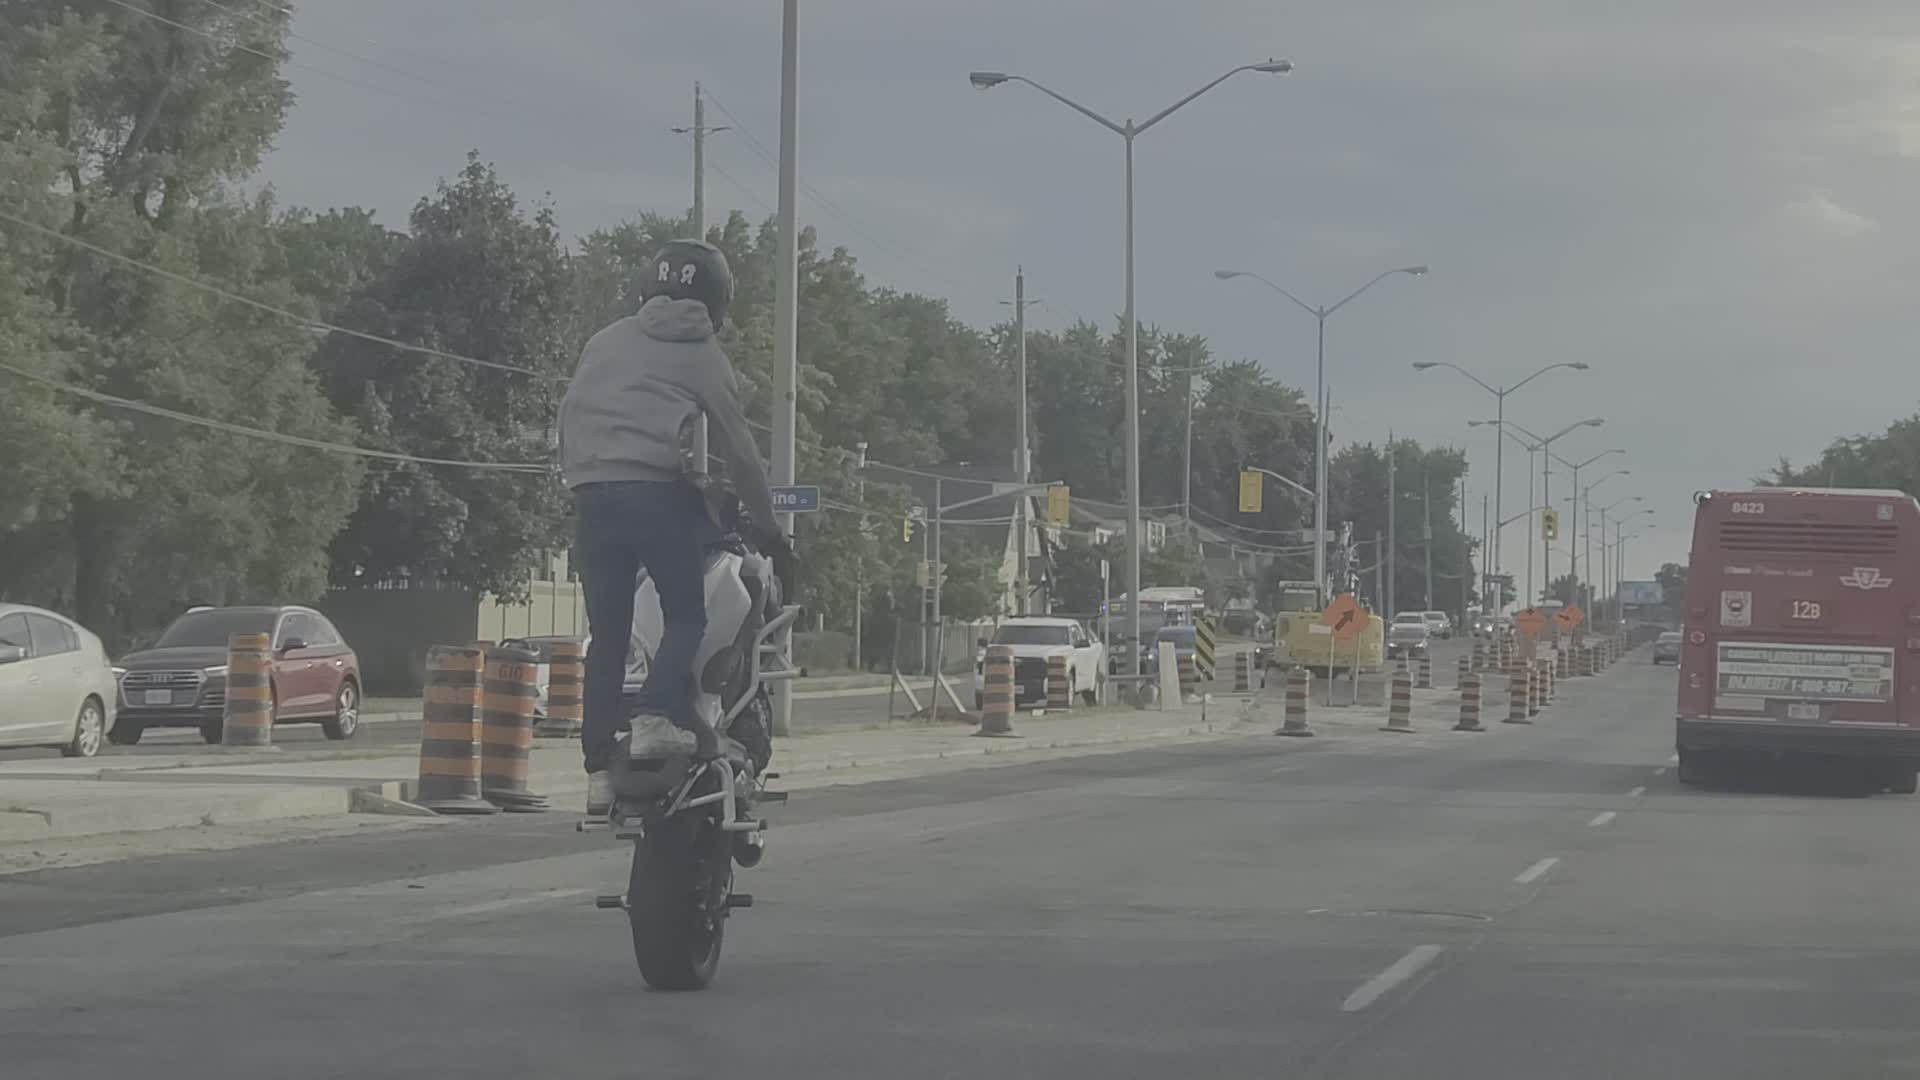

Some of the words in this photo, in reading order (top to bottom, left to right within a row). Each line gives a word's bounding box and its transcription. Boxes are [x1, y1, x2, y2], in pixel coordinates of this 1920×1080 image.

[772, 491, 797, 505] ine
[1732, 502, 1764, 514] 8423
[1792, 601, 1821, 619] 12B
